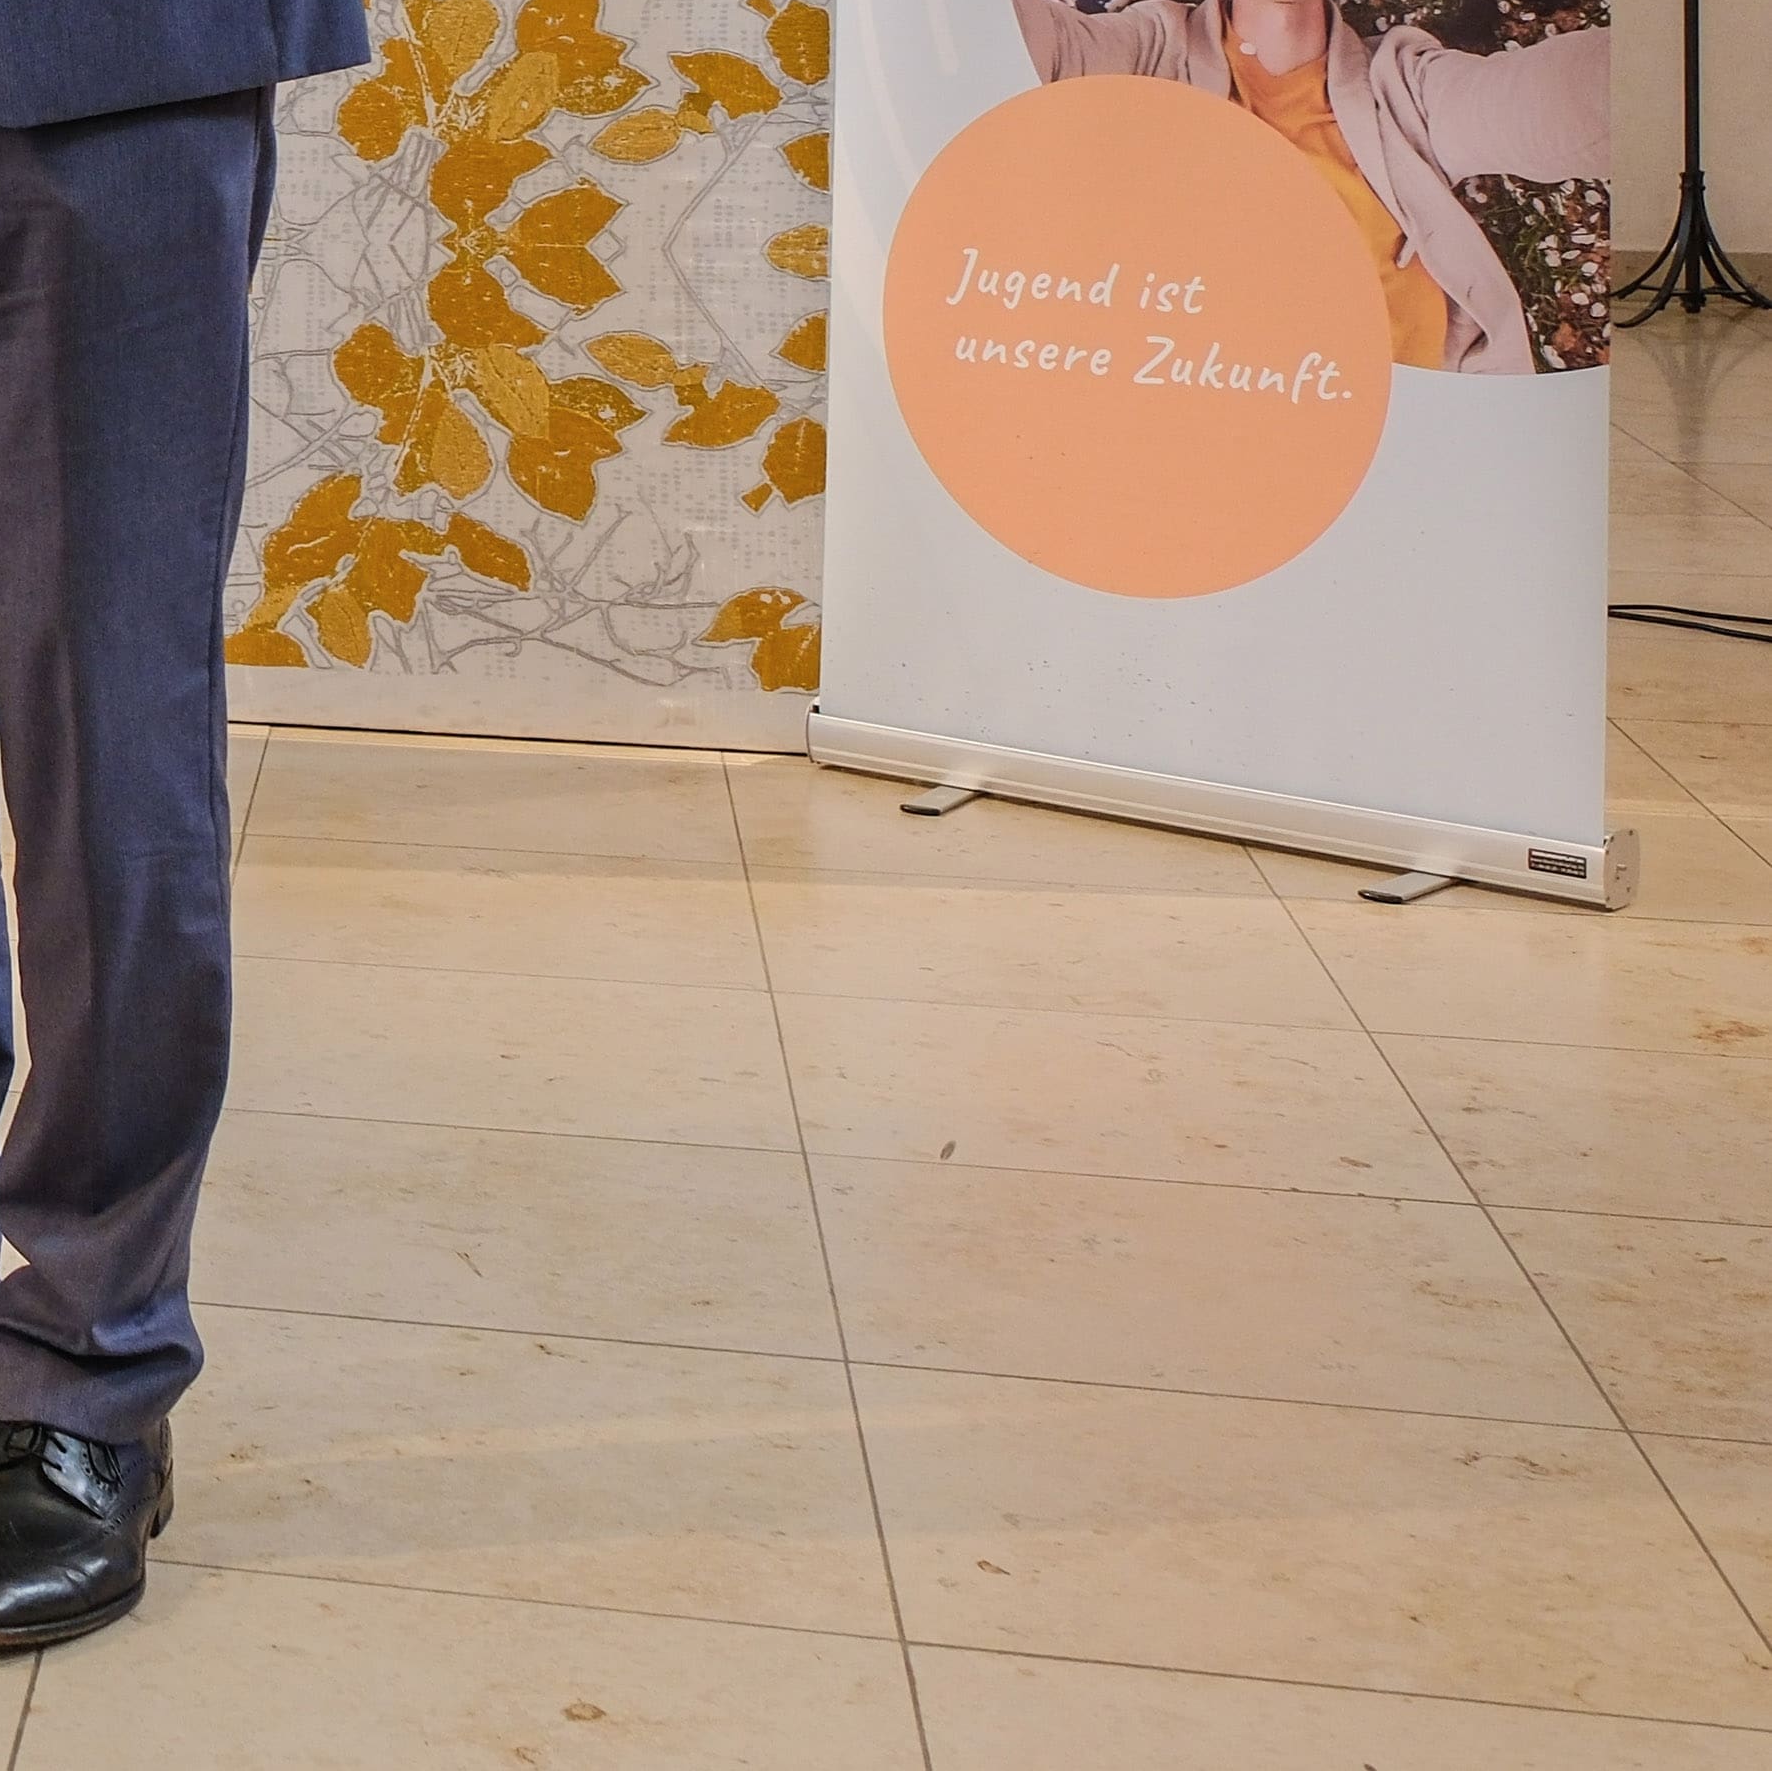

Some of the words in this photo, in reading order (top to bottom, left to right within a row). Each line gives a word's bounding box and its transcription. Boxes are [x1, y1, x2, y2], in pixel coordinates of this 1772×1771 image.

[946, 248, 1121, 310] Jugend
[1139, 272, 1206, 314] ist
[955, 335, 1113, 376] unsere
[1133, 335, 1353, 405] Zukunft.
